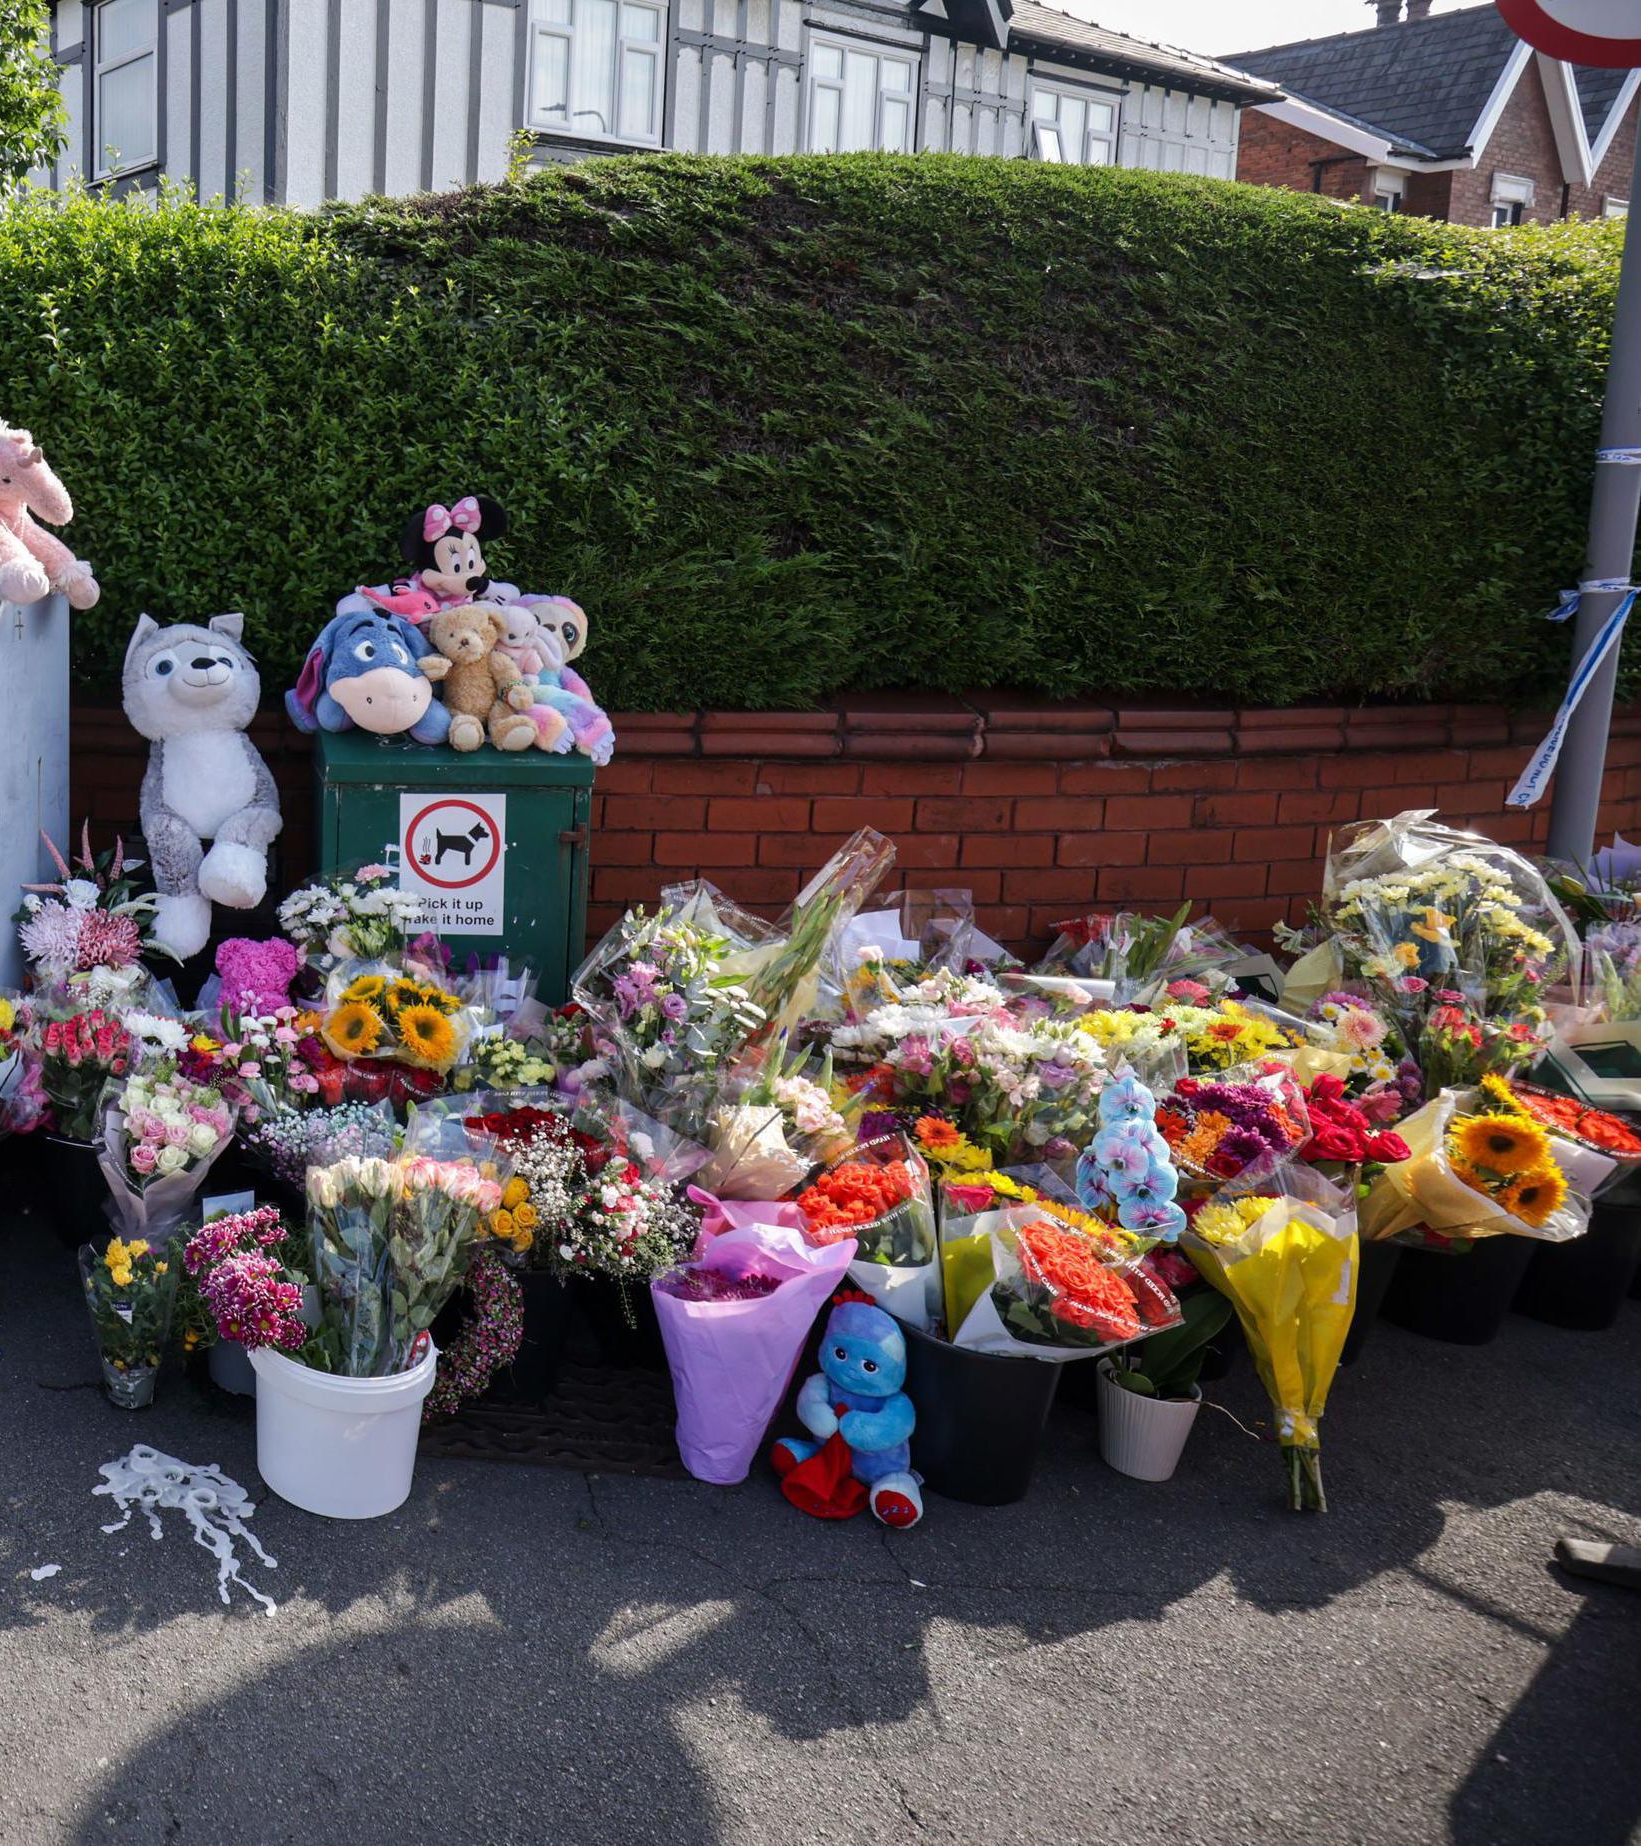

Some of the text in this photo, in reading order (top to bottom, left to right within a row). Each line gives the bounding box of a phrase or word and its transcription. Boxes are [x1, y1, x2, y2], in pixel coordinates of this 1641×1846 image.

[418, 898, 484, 912] Pick it up
[442, 914, 452, 925] it
[456, 914, 495, 925] home
[829, 1226, 852, 1235] HAND
[853, 1221, 881, 1231] PICKED
[1041, 1276, 1059, 1297] CARE
[1069, 1300, 1095, 1314] HAND
